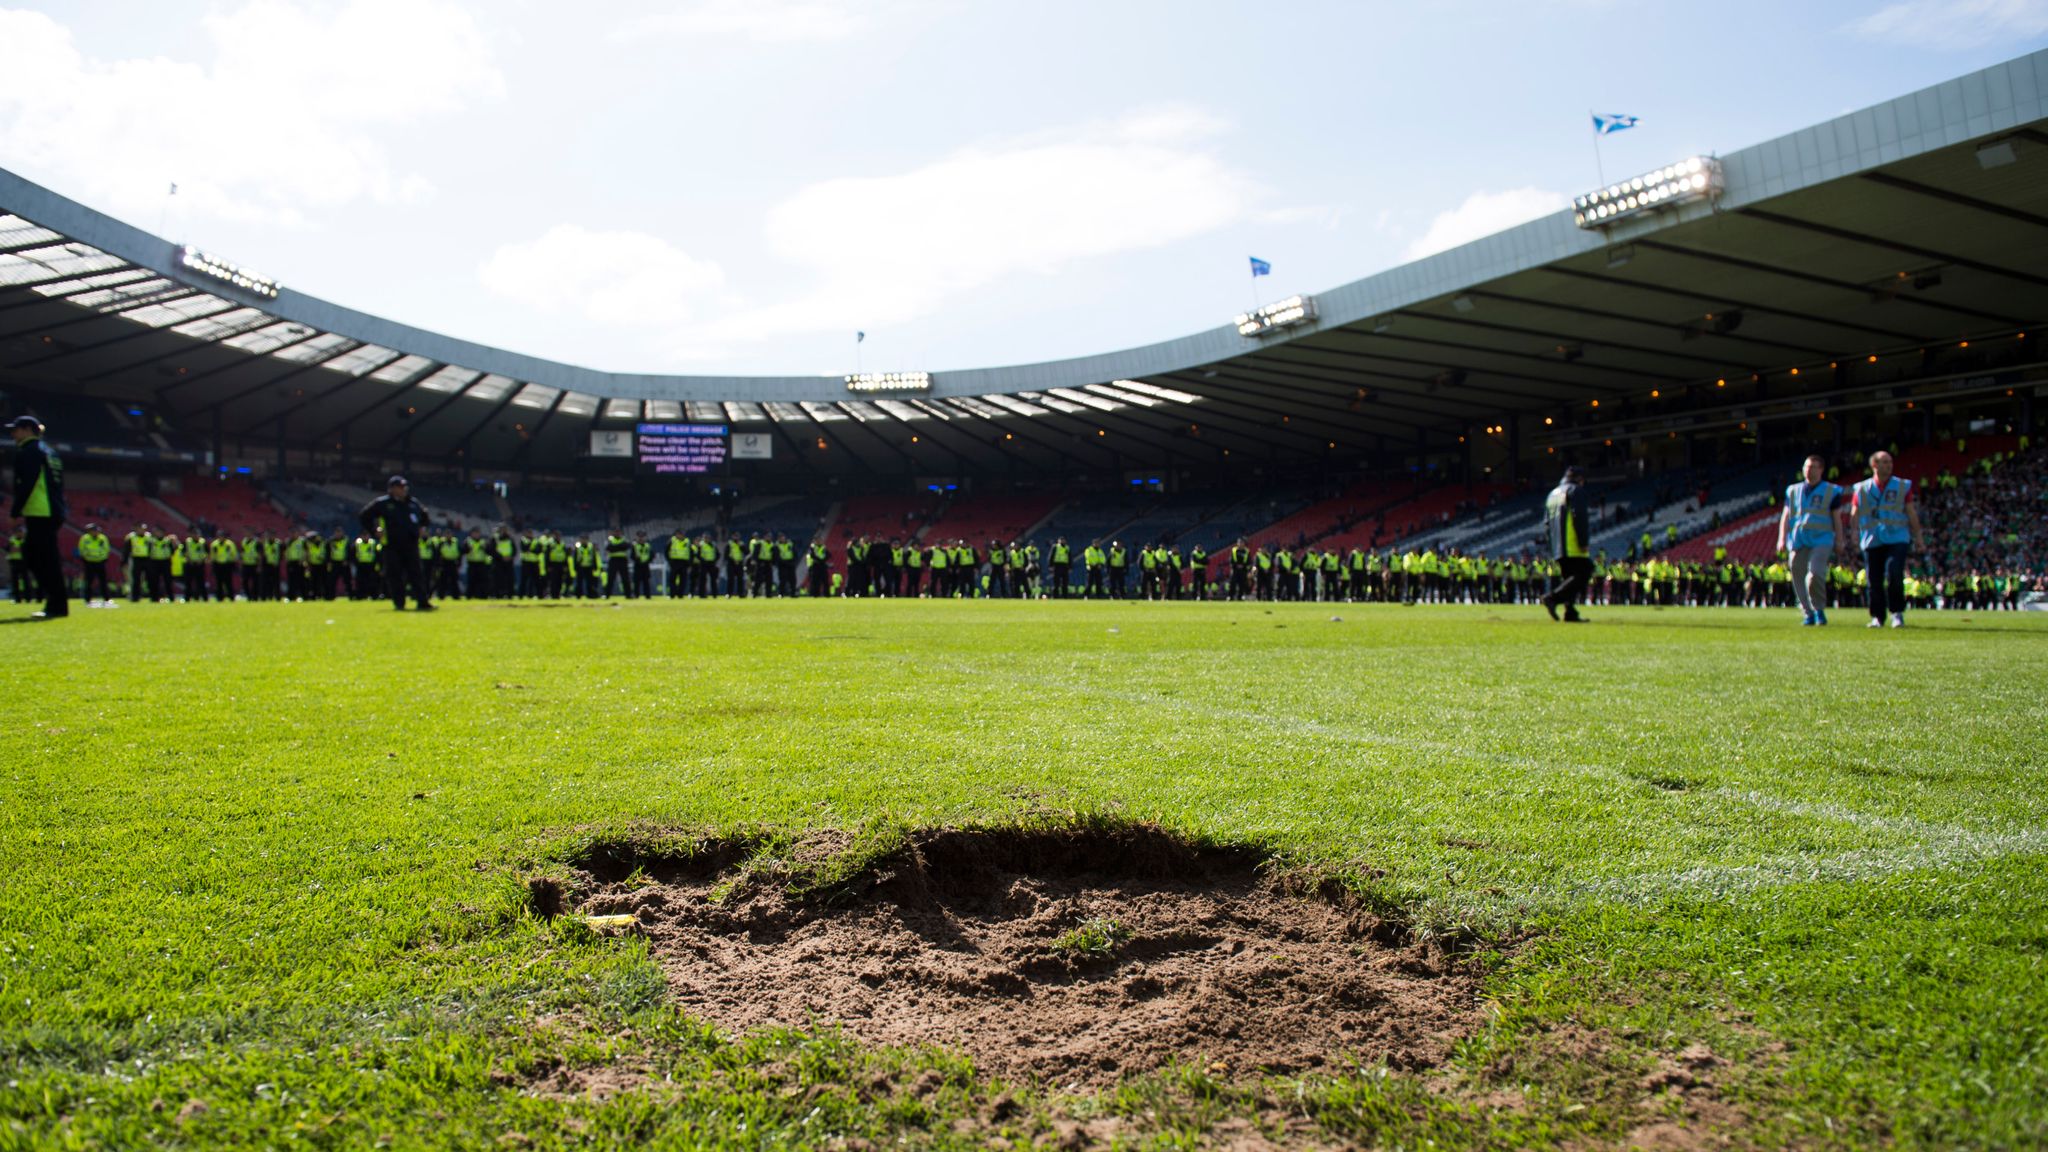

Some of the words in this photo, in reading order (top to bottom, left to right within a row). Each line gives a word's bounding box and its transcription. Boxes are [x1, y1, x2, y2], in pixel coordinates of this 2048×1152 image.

[665, 425, 690, 433] POLICE
[640, 436, 666, 444] Please
[702, 437, 723, 445] pitch.
[639, 445, 660, 453] There
[701, 446, 726, 455] trophy
[641, 455, 690, 463] presentation
[656, 464, 676, 472] pitch
[686, 464, 707, 472] clear.
